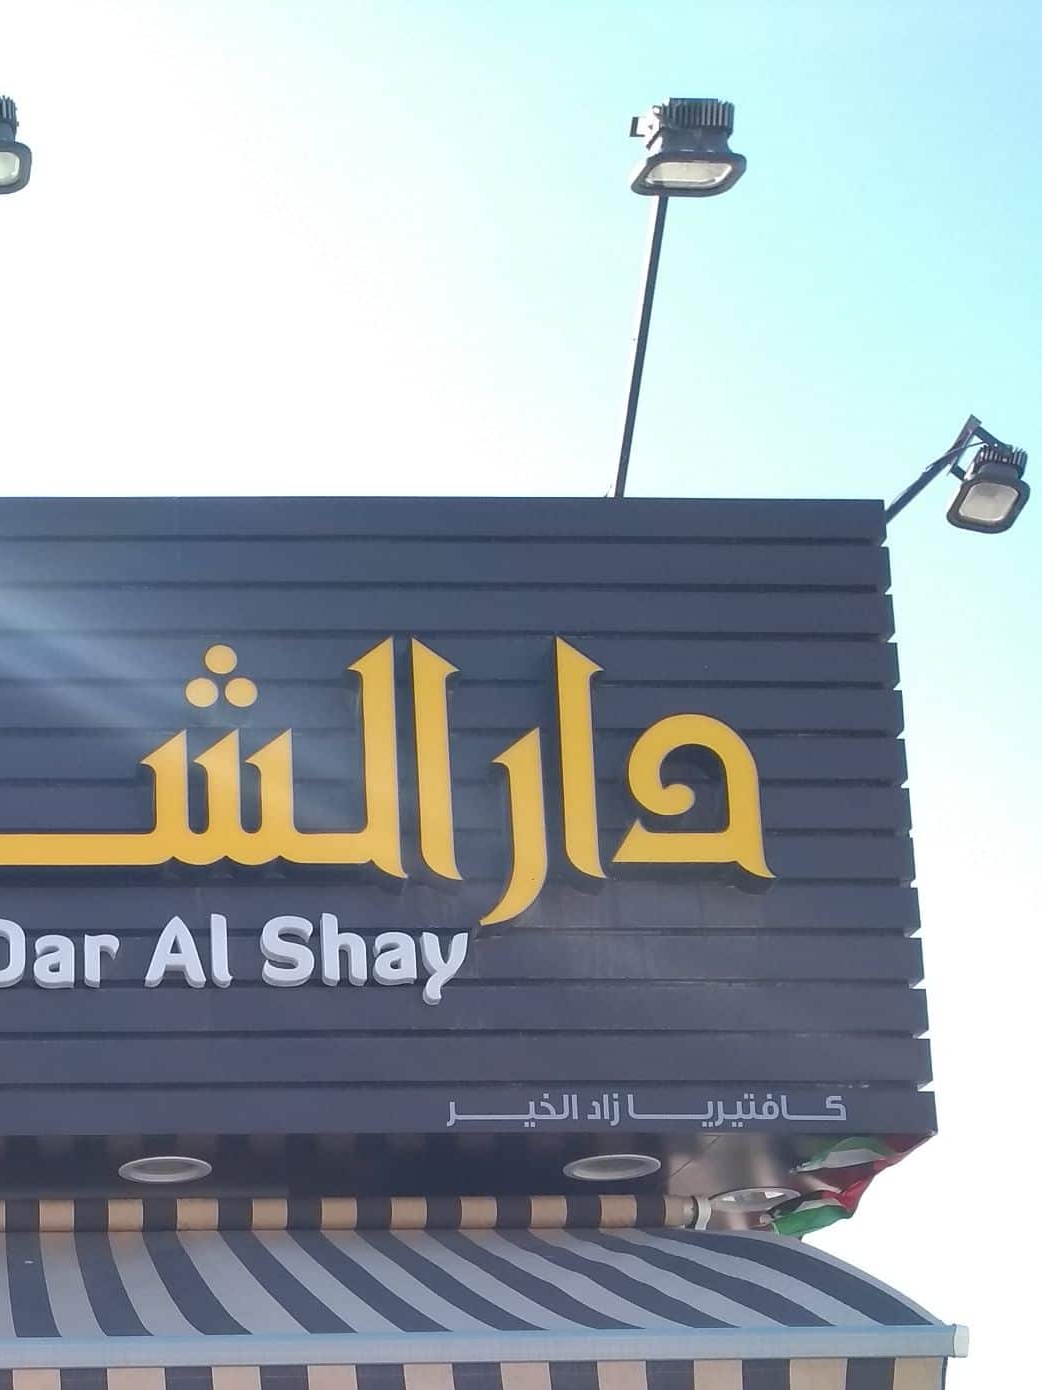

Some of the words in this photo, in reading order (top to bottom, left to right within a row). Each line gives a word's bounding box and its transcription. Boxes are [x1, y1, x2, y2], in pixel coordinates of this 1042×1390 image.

[481, 636, 778, 926] دار
[144, 912, 233, 989] Al
[261, 912, 469, 1005] Shay
[447, 1093, 579, 1127] الخير
[587, 1093, 621, 1126] زاد
[627, 1093, 847, 1127] كافتيريا
